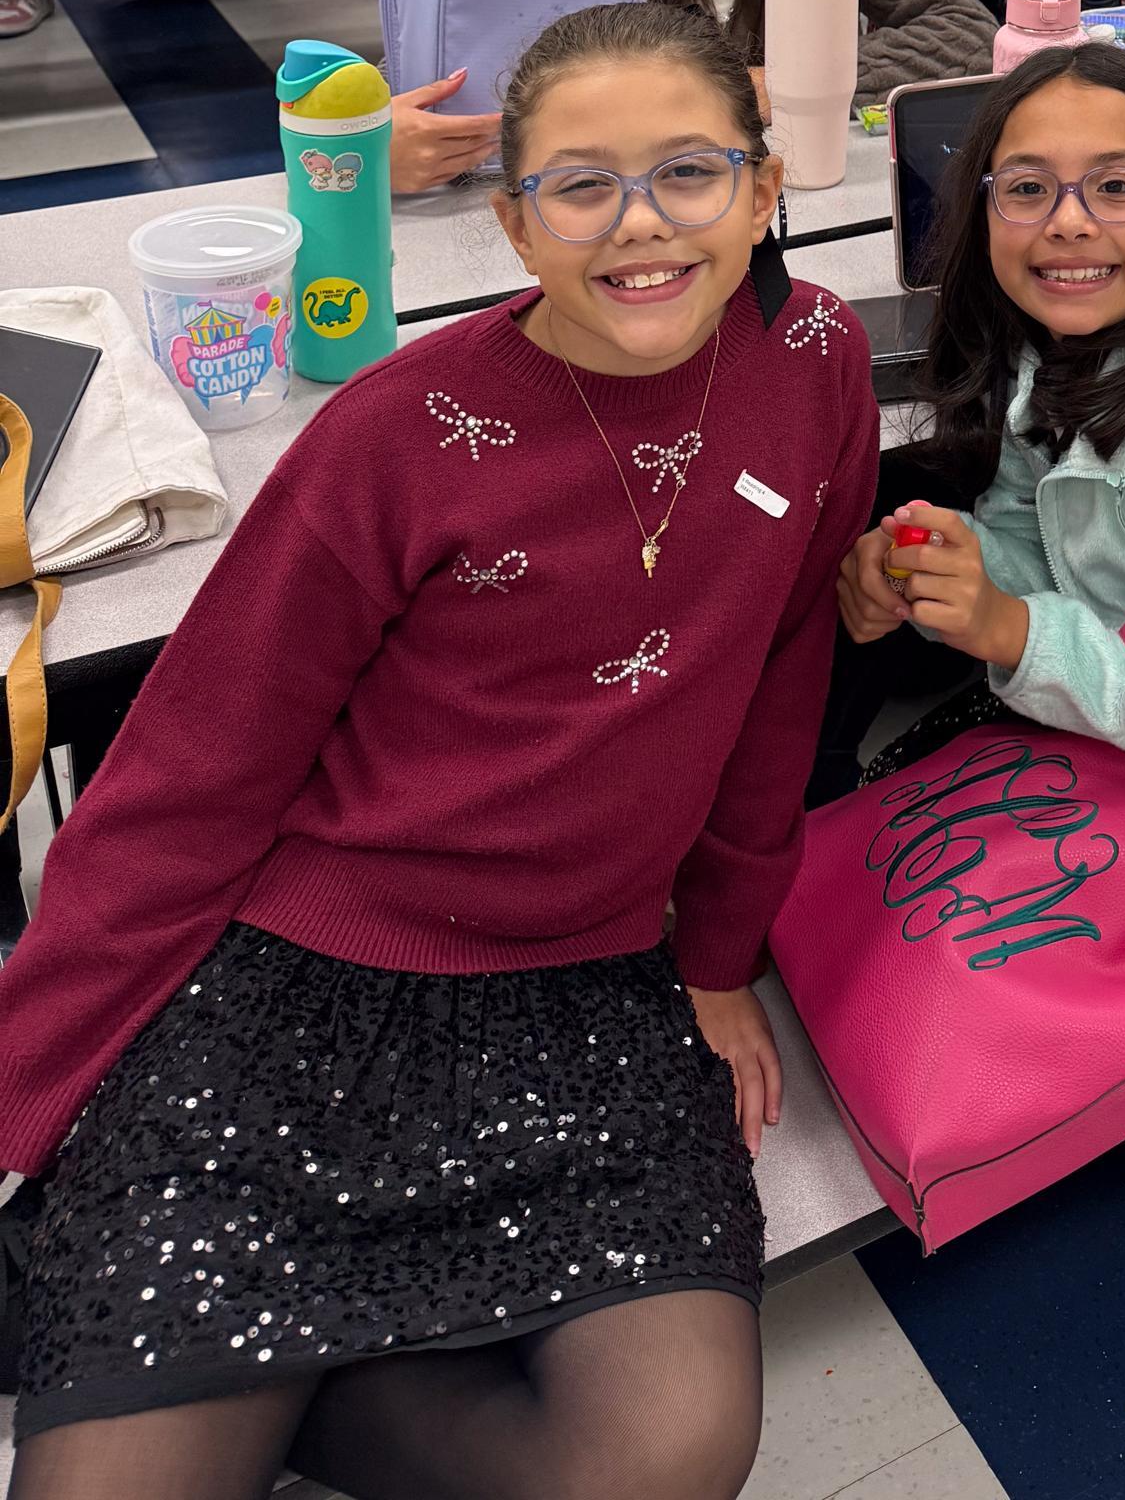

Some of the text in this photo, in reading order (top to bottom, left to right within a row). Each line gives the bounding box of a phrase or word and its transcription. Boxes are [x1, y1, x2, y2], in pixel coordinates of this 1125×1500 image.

[189, 345, 266, 376] COTTON
[192, 337, 245, 359] PARADE
[197, 366, 262, 395] CANDY
